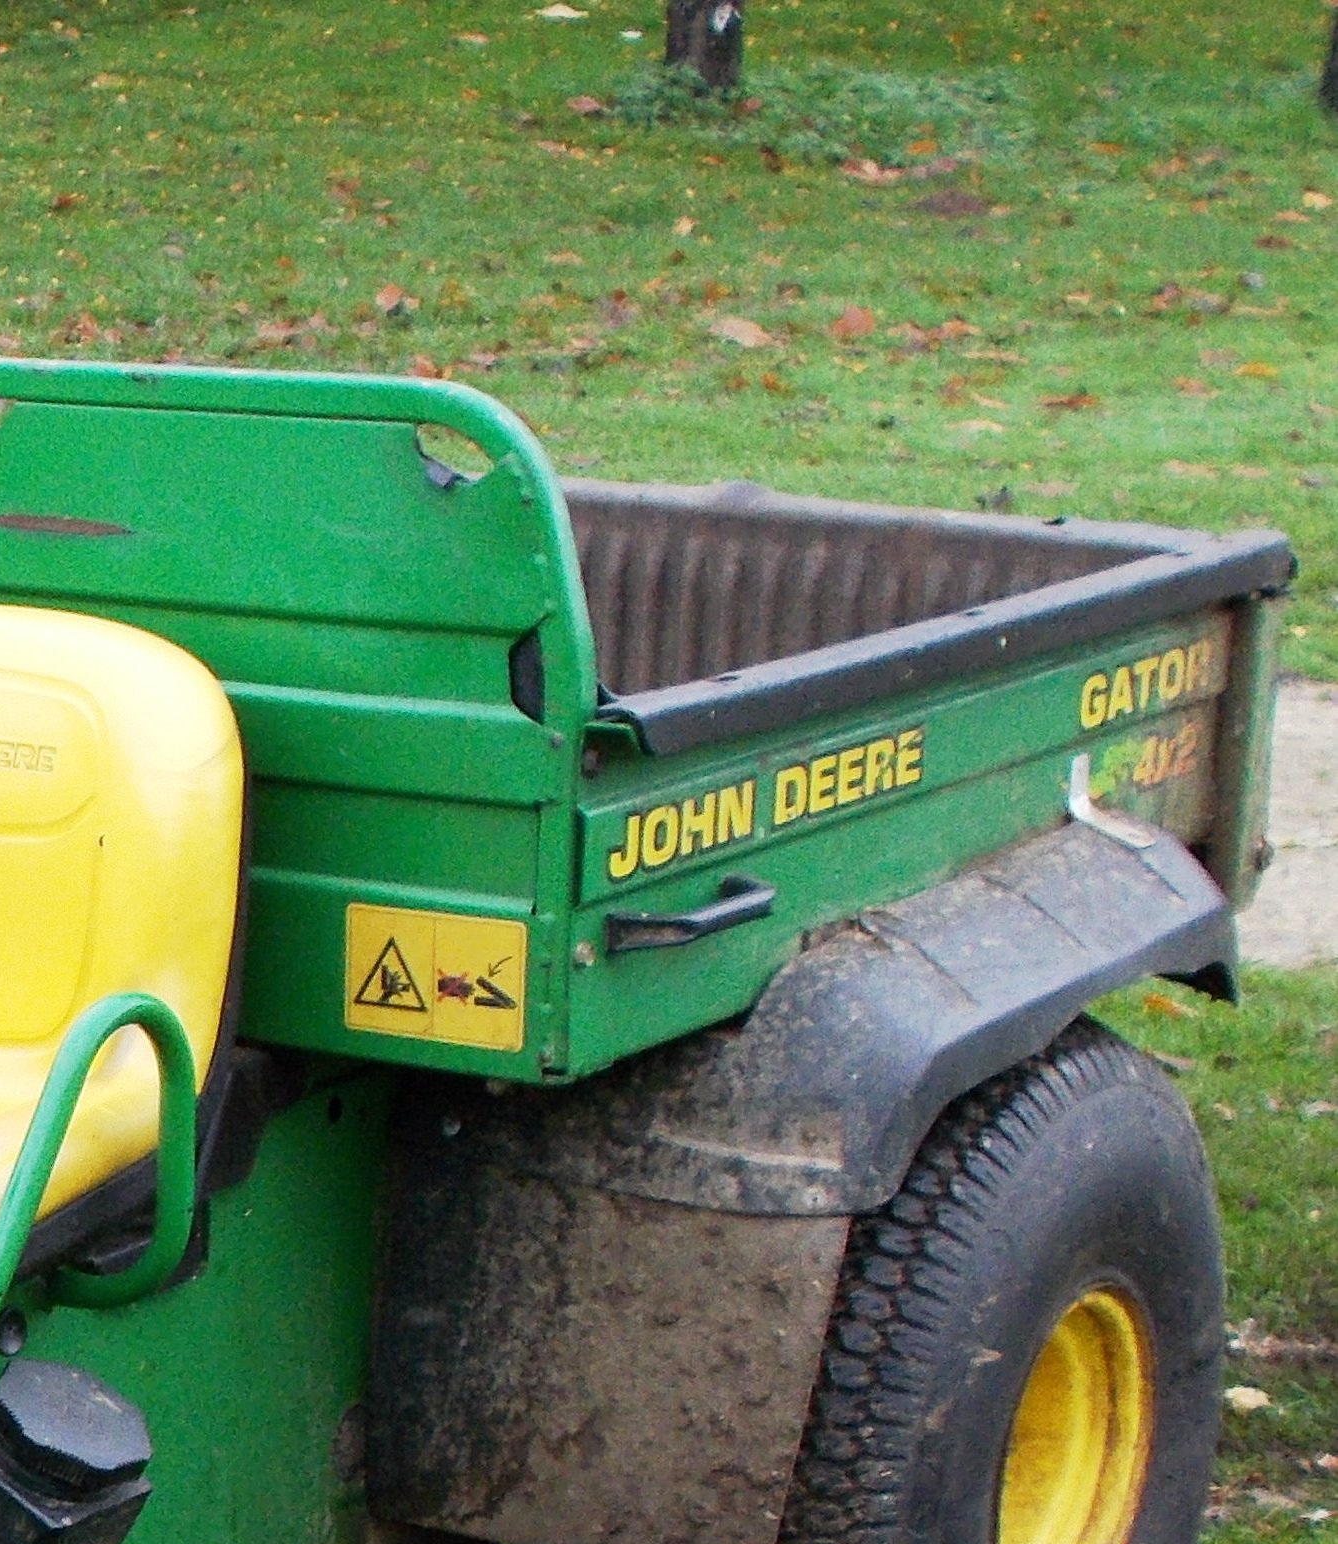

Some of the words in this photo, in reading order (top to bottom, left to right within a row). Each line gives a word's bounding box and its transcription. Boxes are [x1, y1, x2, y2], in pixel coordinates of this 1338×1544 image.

[1079, 638, 1213, 729] GATOR
[608, 779, 755, 879] JOHN
[773, 729, 923, 826] DEERE
